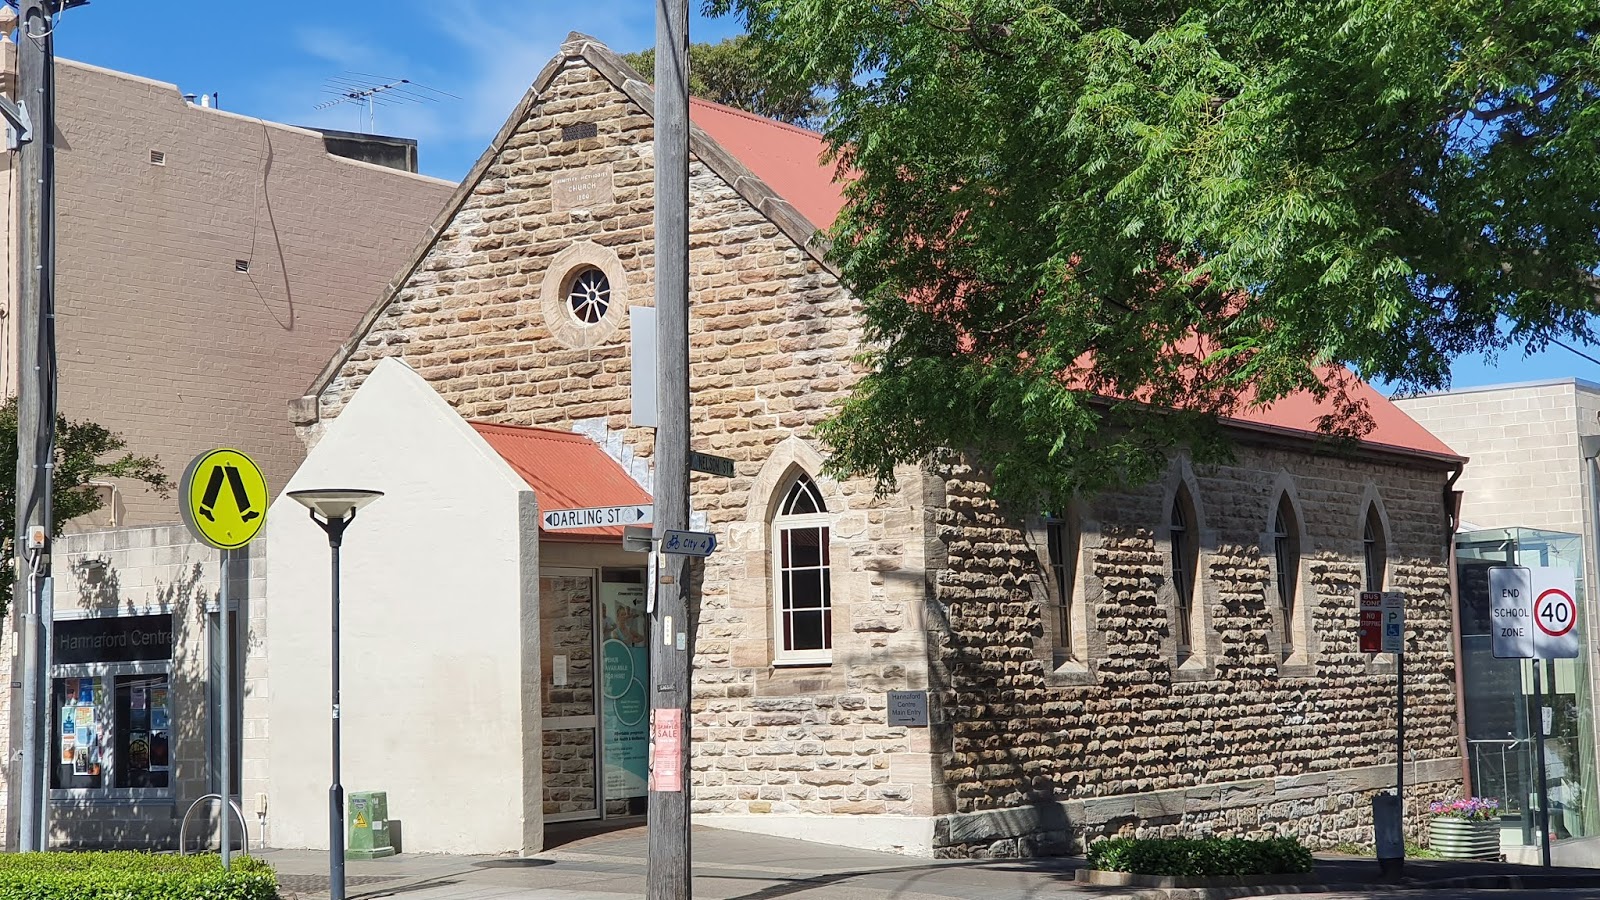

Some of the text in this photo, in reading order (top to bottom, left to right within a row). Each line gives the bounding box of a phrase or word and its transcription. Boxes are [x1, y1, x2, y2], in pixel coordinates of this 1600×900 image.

[568, 182, 597, 192] CHURCH
[698, 455, 729, 474] NELSON ST
[553, 508, 621, 527] DARLING ST
[683, 538, 706, 551] City 4
[1502, 588, 1520, 598] END
[1366, 612, 1376, 620] NO
[1388, 612, 1398, 623] P
[1494, 608, 1530, 618] SCHOOL
[1541, 602, 1568, 623] 40
[1501, 627, 1525, 637] ZONE
[60, 629, 173, 649] Hannaford Centre
[657, 730, 678, 738] SALE
